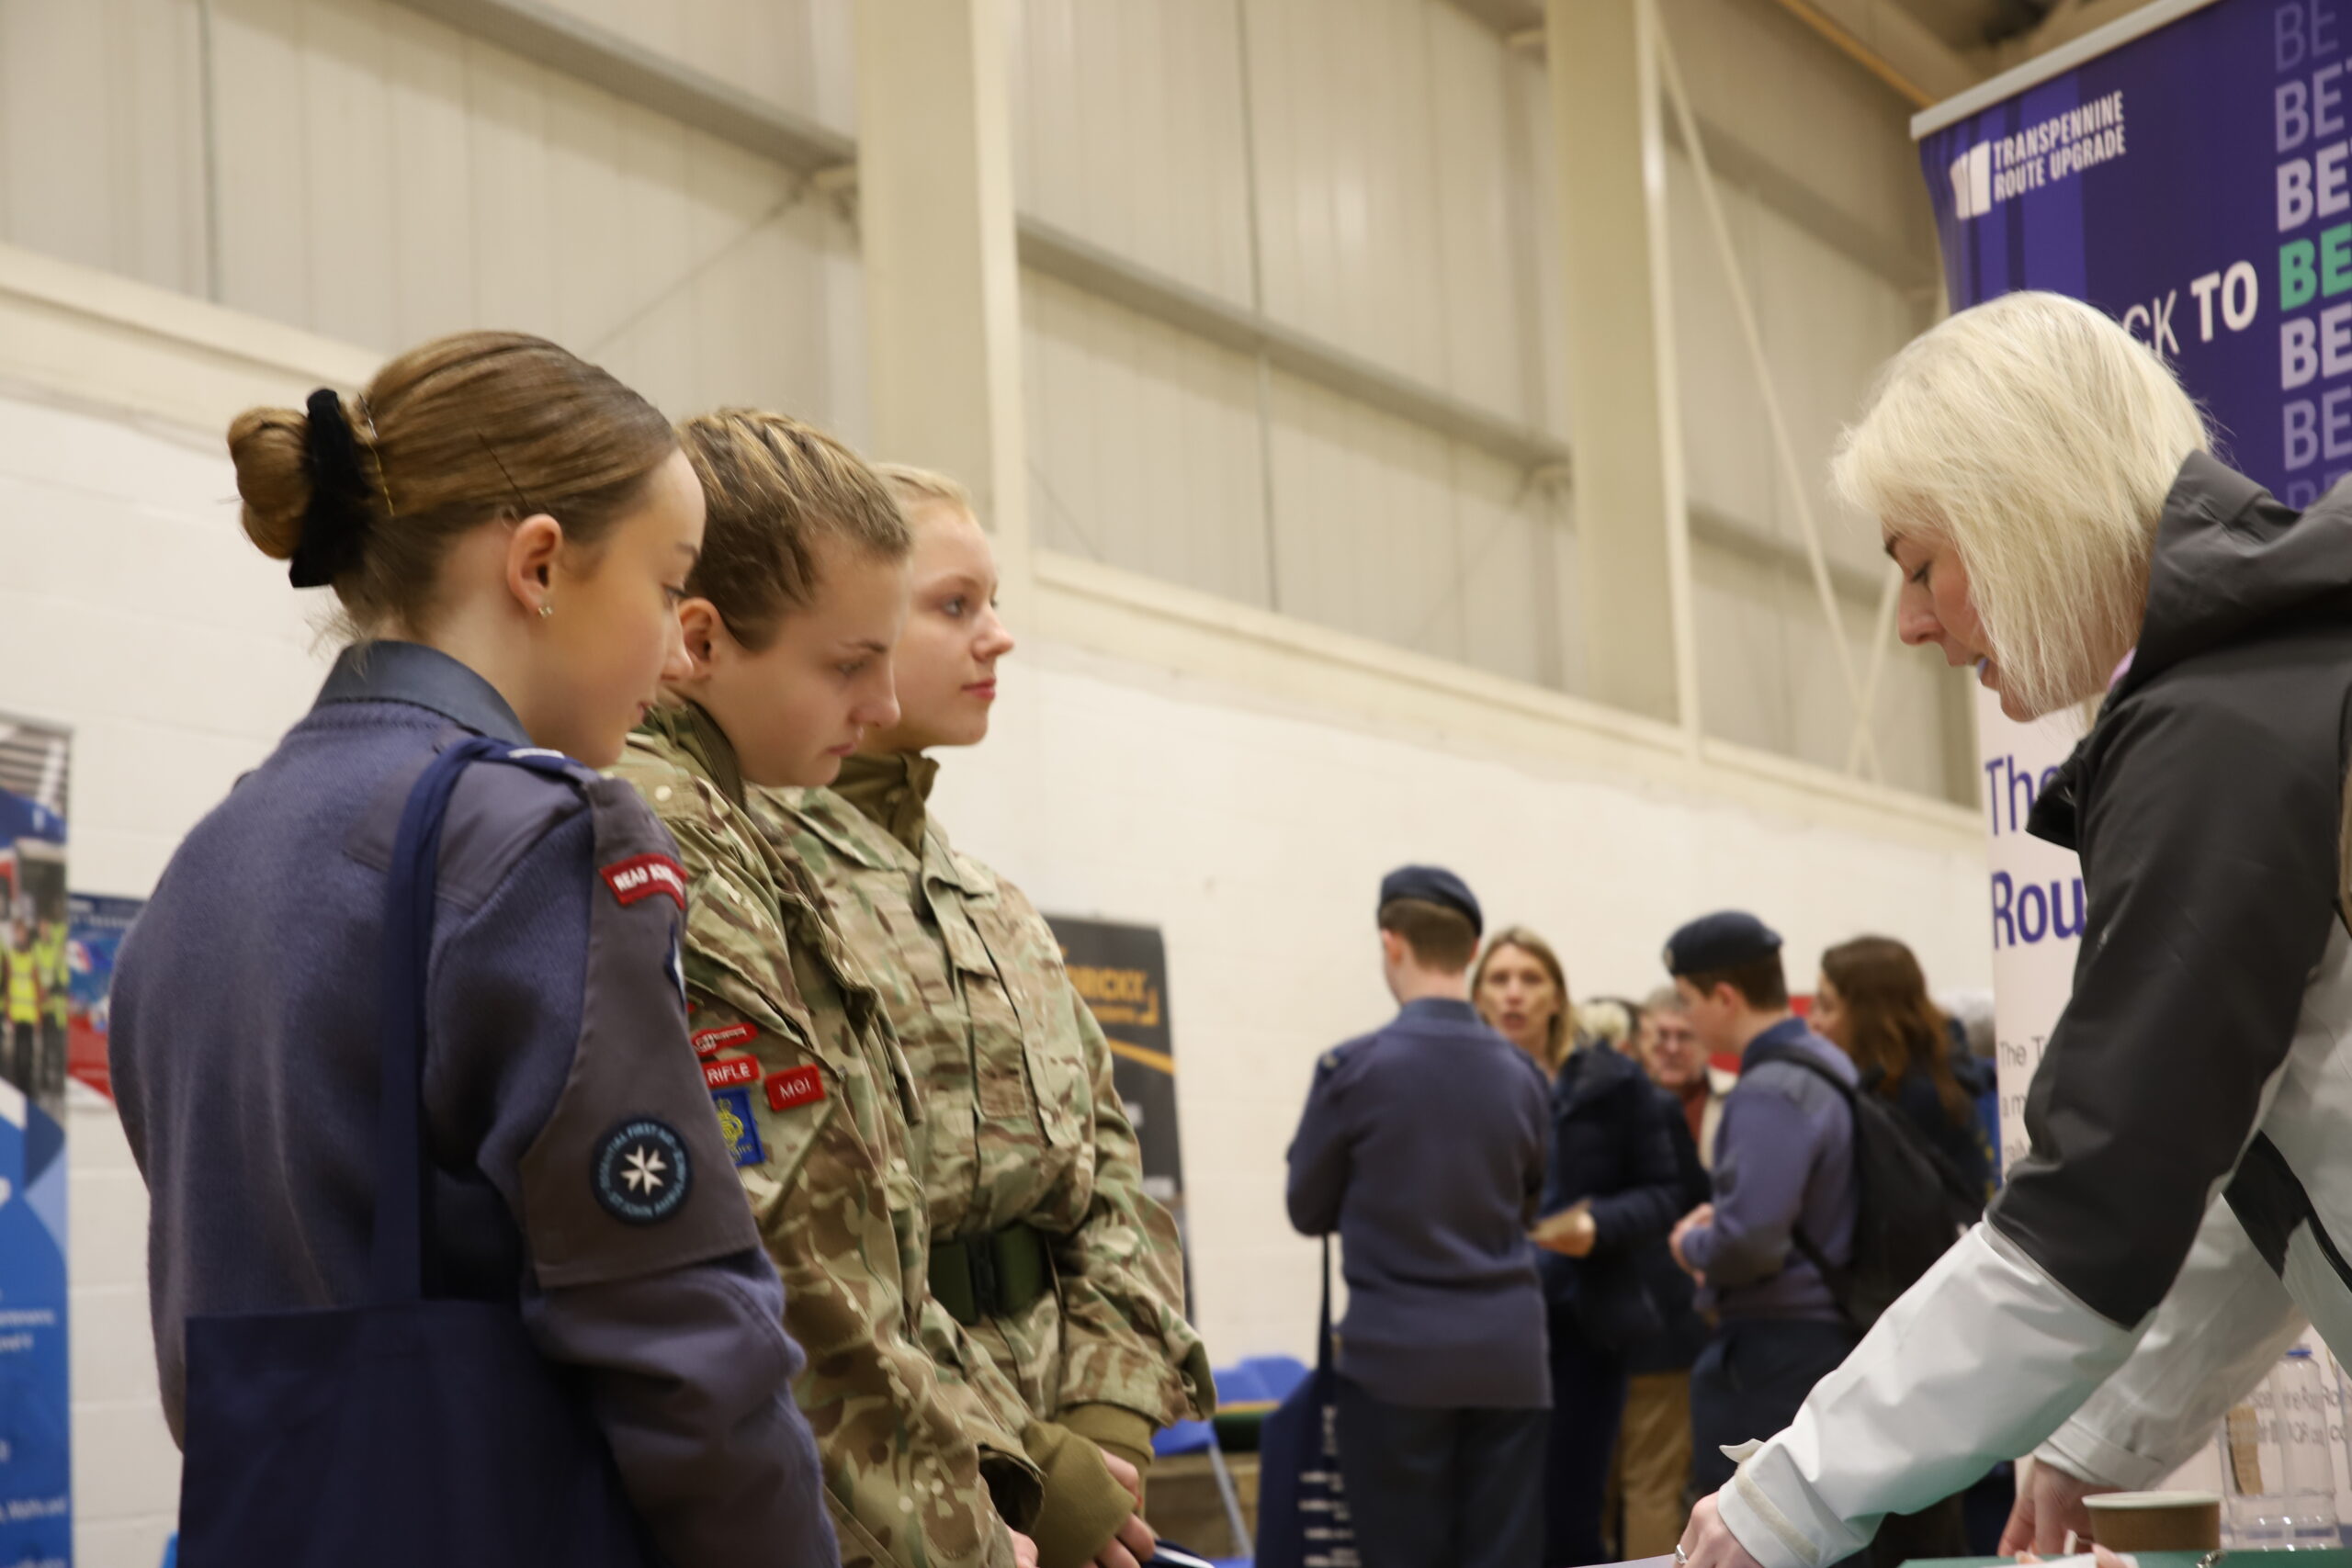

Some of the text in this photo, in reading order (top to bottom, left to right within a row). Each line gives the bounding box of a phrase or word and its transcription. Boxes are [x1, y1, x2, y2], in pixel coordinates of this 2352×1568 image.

[1994, 90, 2123, 171] TRANSPENNINE
[2276, 60, 2352, 153] BE
[1995, 124, 2126, 202] ROUTE UPGRADE
[2278, 139, 2352, 232] BE
[2190, 260, 2257, 343] TO
[2279, 221, 2352, 311] BE
[2281, 301, 2352, 390] BE
[2284, 385, 2352, 472] BE
[707, 1062, 752, 1085] RIFLE
